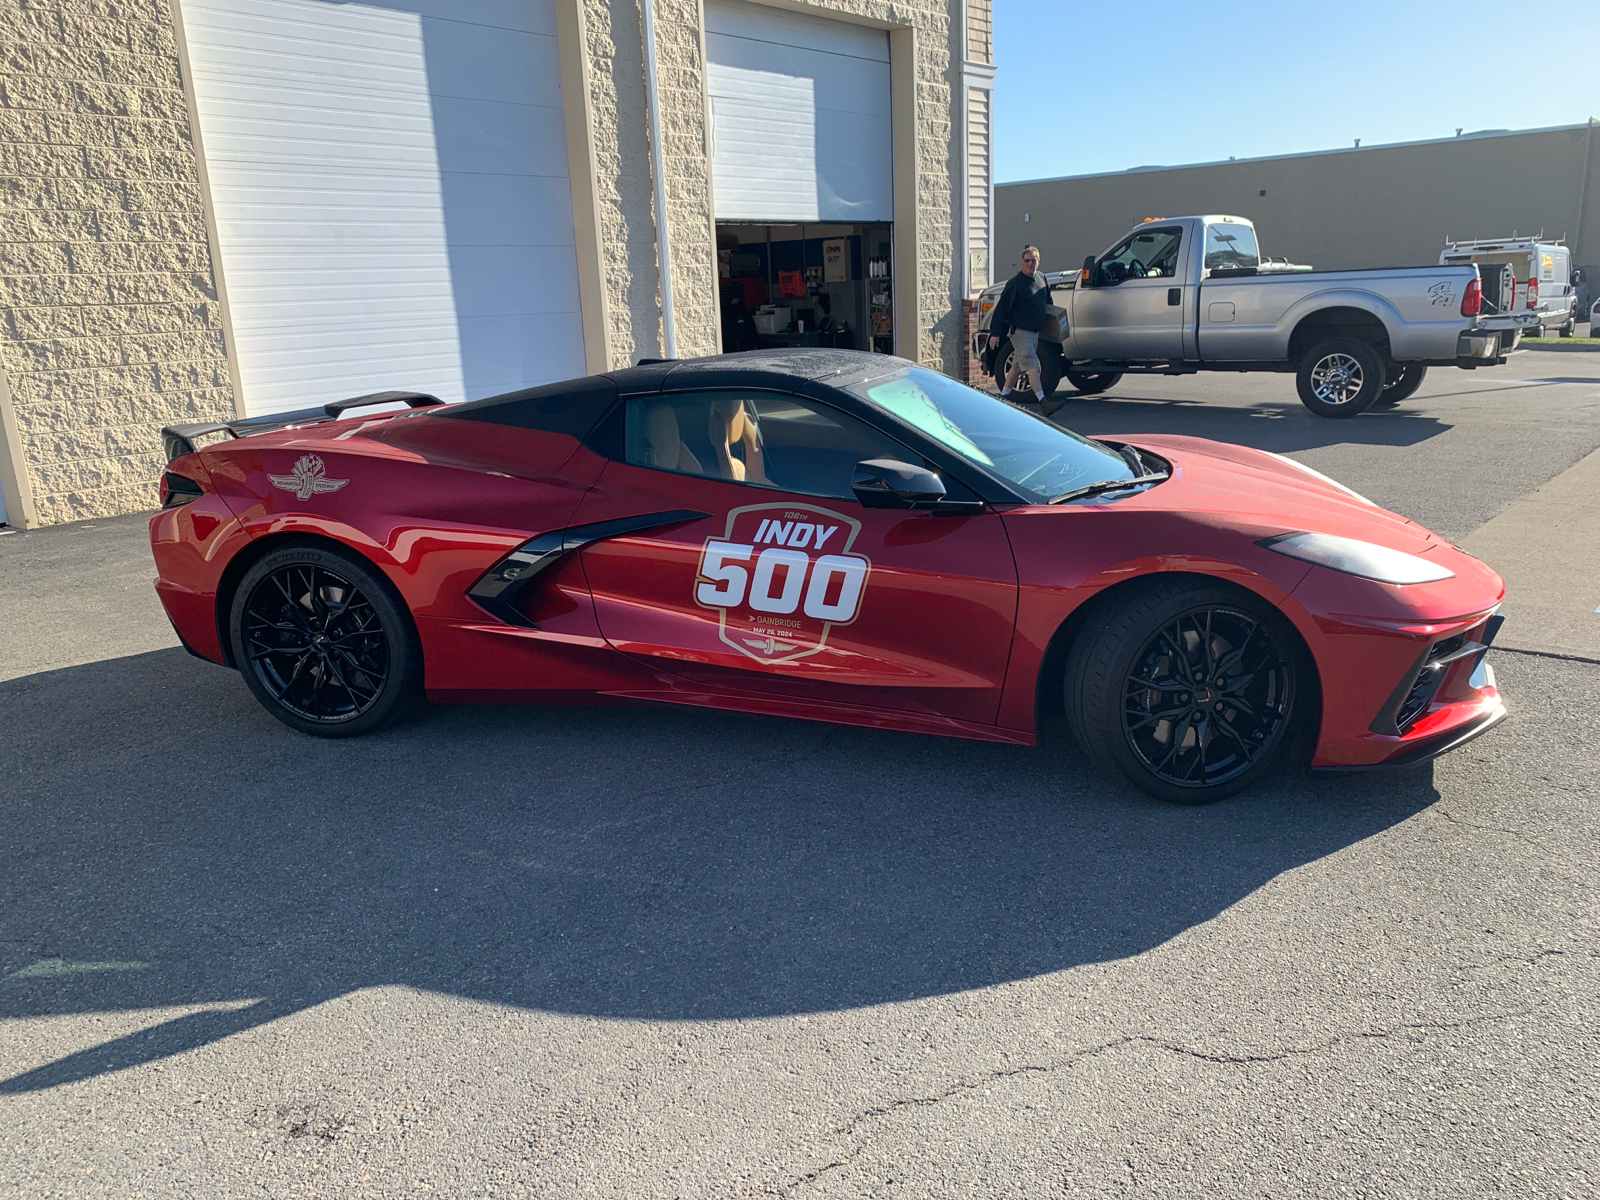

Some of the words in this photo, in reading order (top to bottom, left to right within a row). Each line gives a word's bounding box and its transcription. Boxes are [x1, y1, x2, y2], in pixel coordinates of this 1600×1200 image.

[783, 511, 808, 520] 108TH
[753, 518, 838, 550] INDY
[276, 552, 320, 562] MICHELIN
[697, 540, 867, 622] 500
[757, 615, 802, 629] GAINBRIDGE
